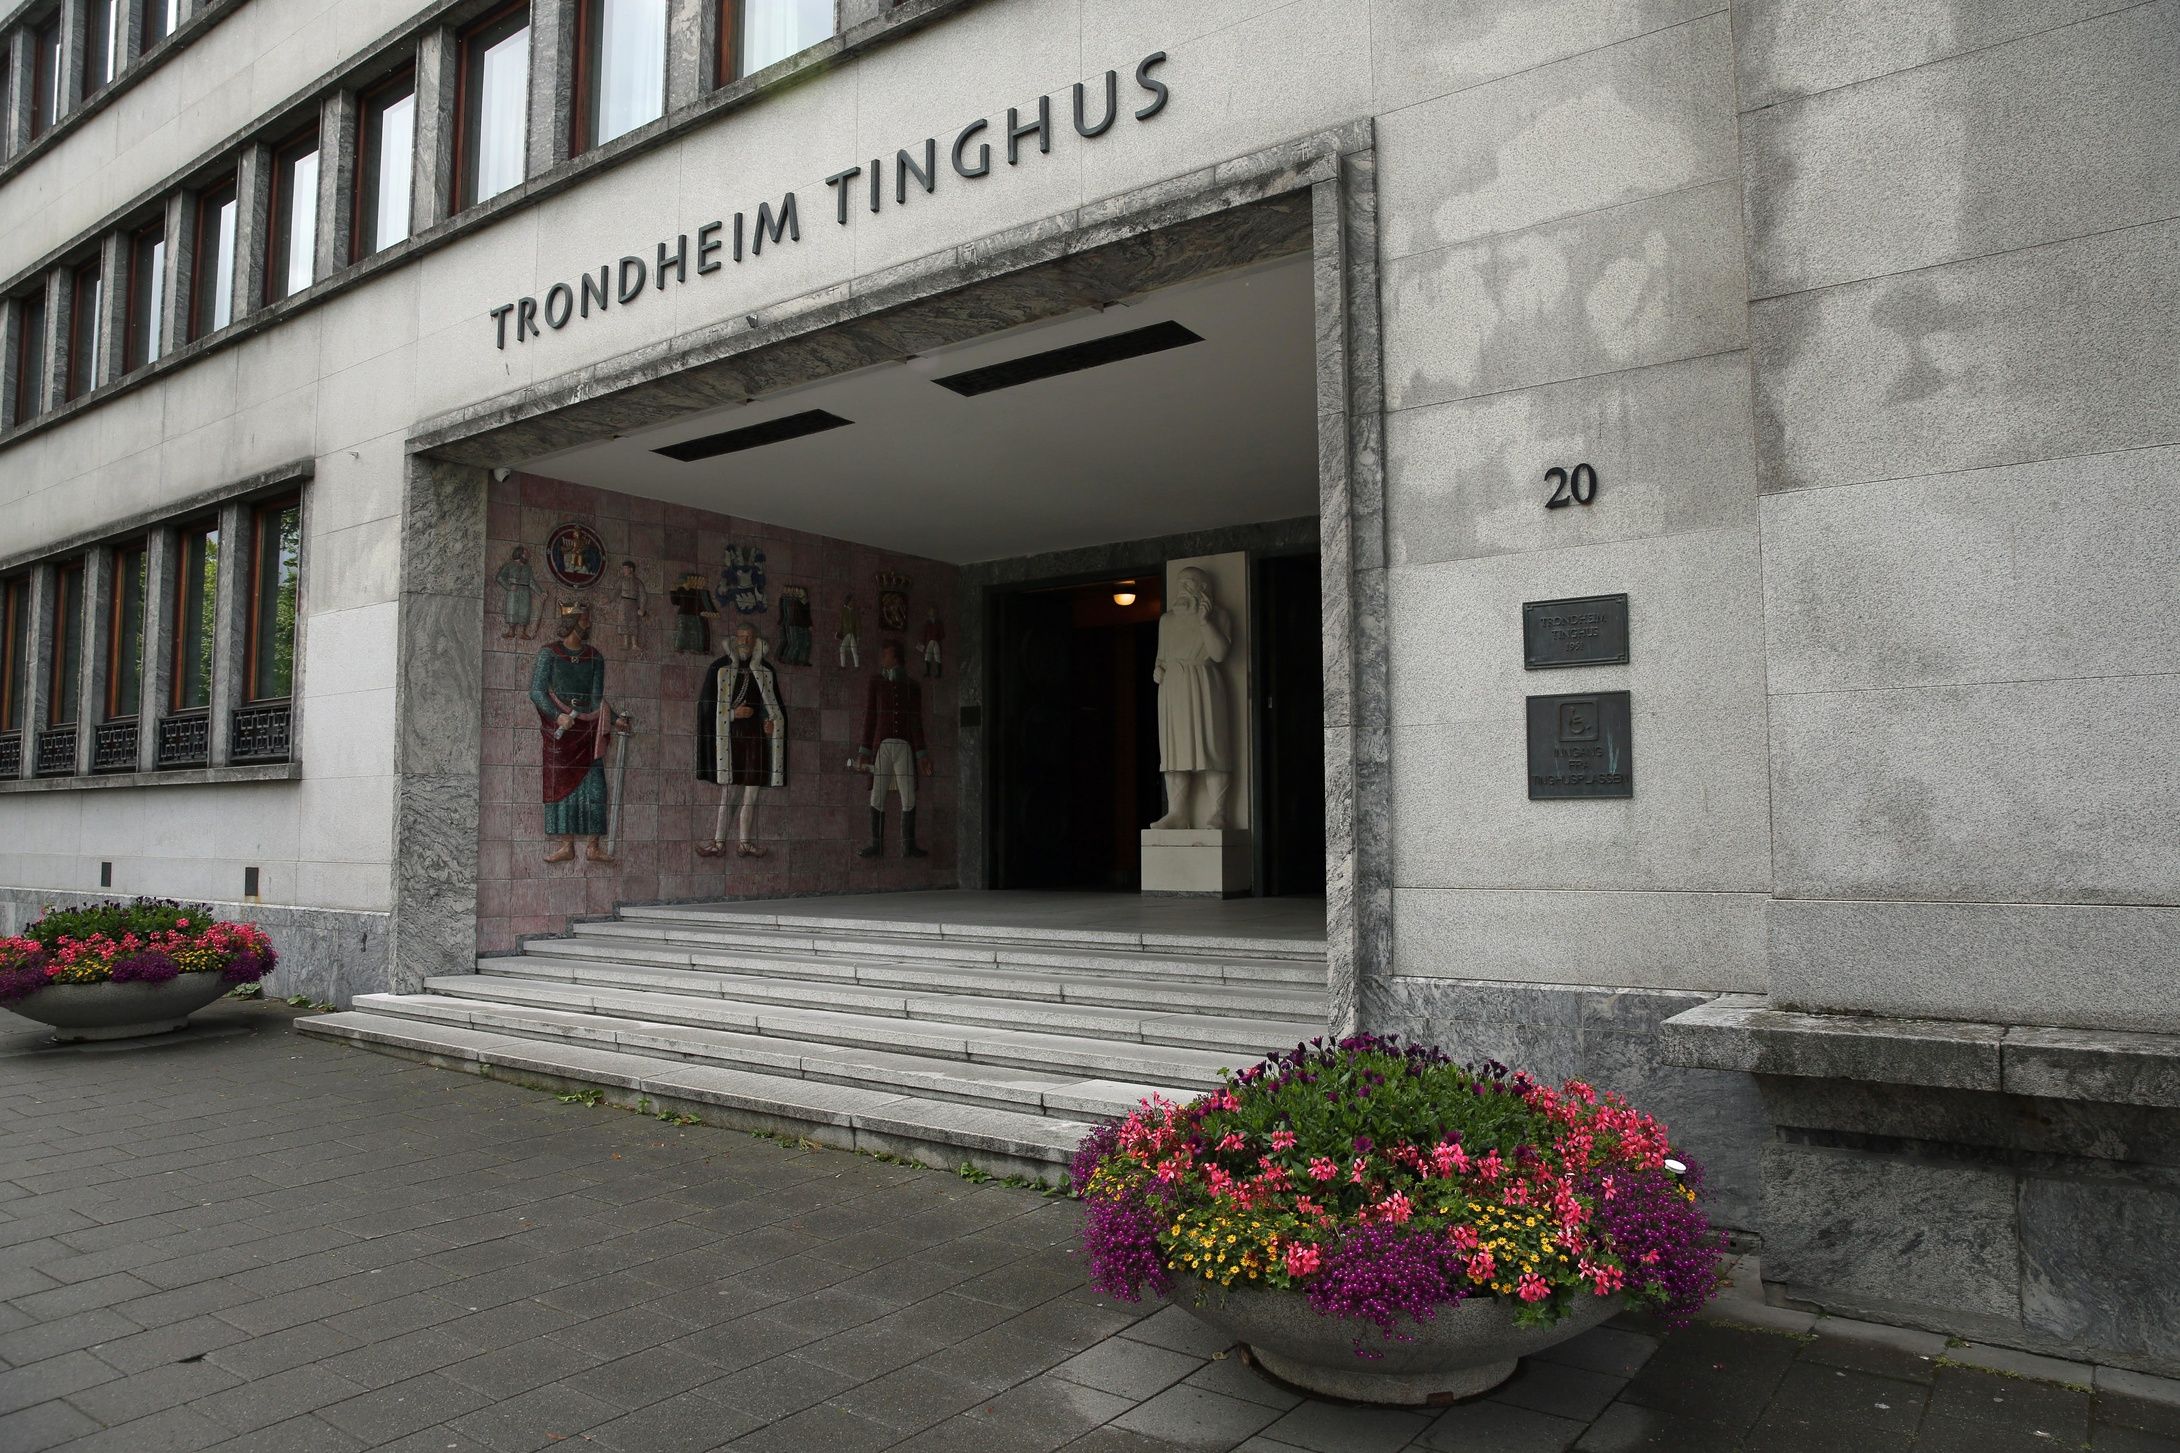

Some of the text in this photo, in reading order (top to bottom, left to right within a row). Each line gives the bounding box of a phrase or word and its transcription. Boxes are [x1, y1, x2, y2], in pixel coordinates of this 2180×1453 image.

[490, 50, 1169, 351] TRONDHEIM TINGHUS
[1543, 462, 1597, 509] 20
[1539, 613, 1607, 628] TRONDHEIM
[1551, 626, 1598, 640] TINGHUS
[1553, 745, 1604, 758] INNGANG
[1568, 758, 1589, 770] FRA
[1532, 772, 1630, 785] TINGHUSPLASSEN
